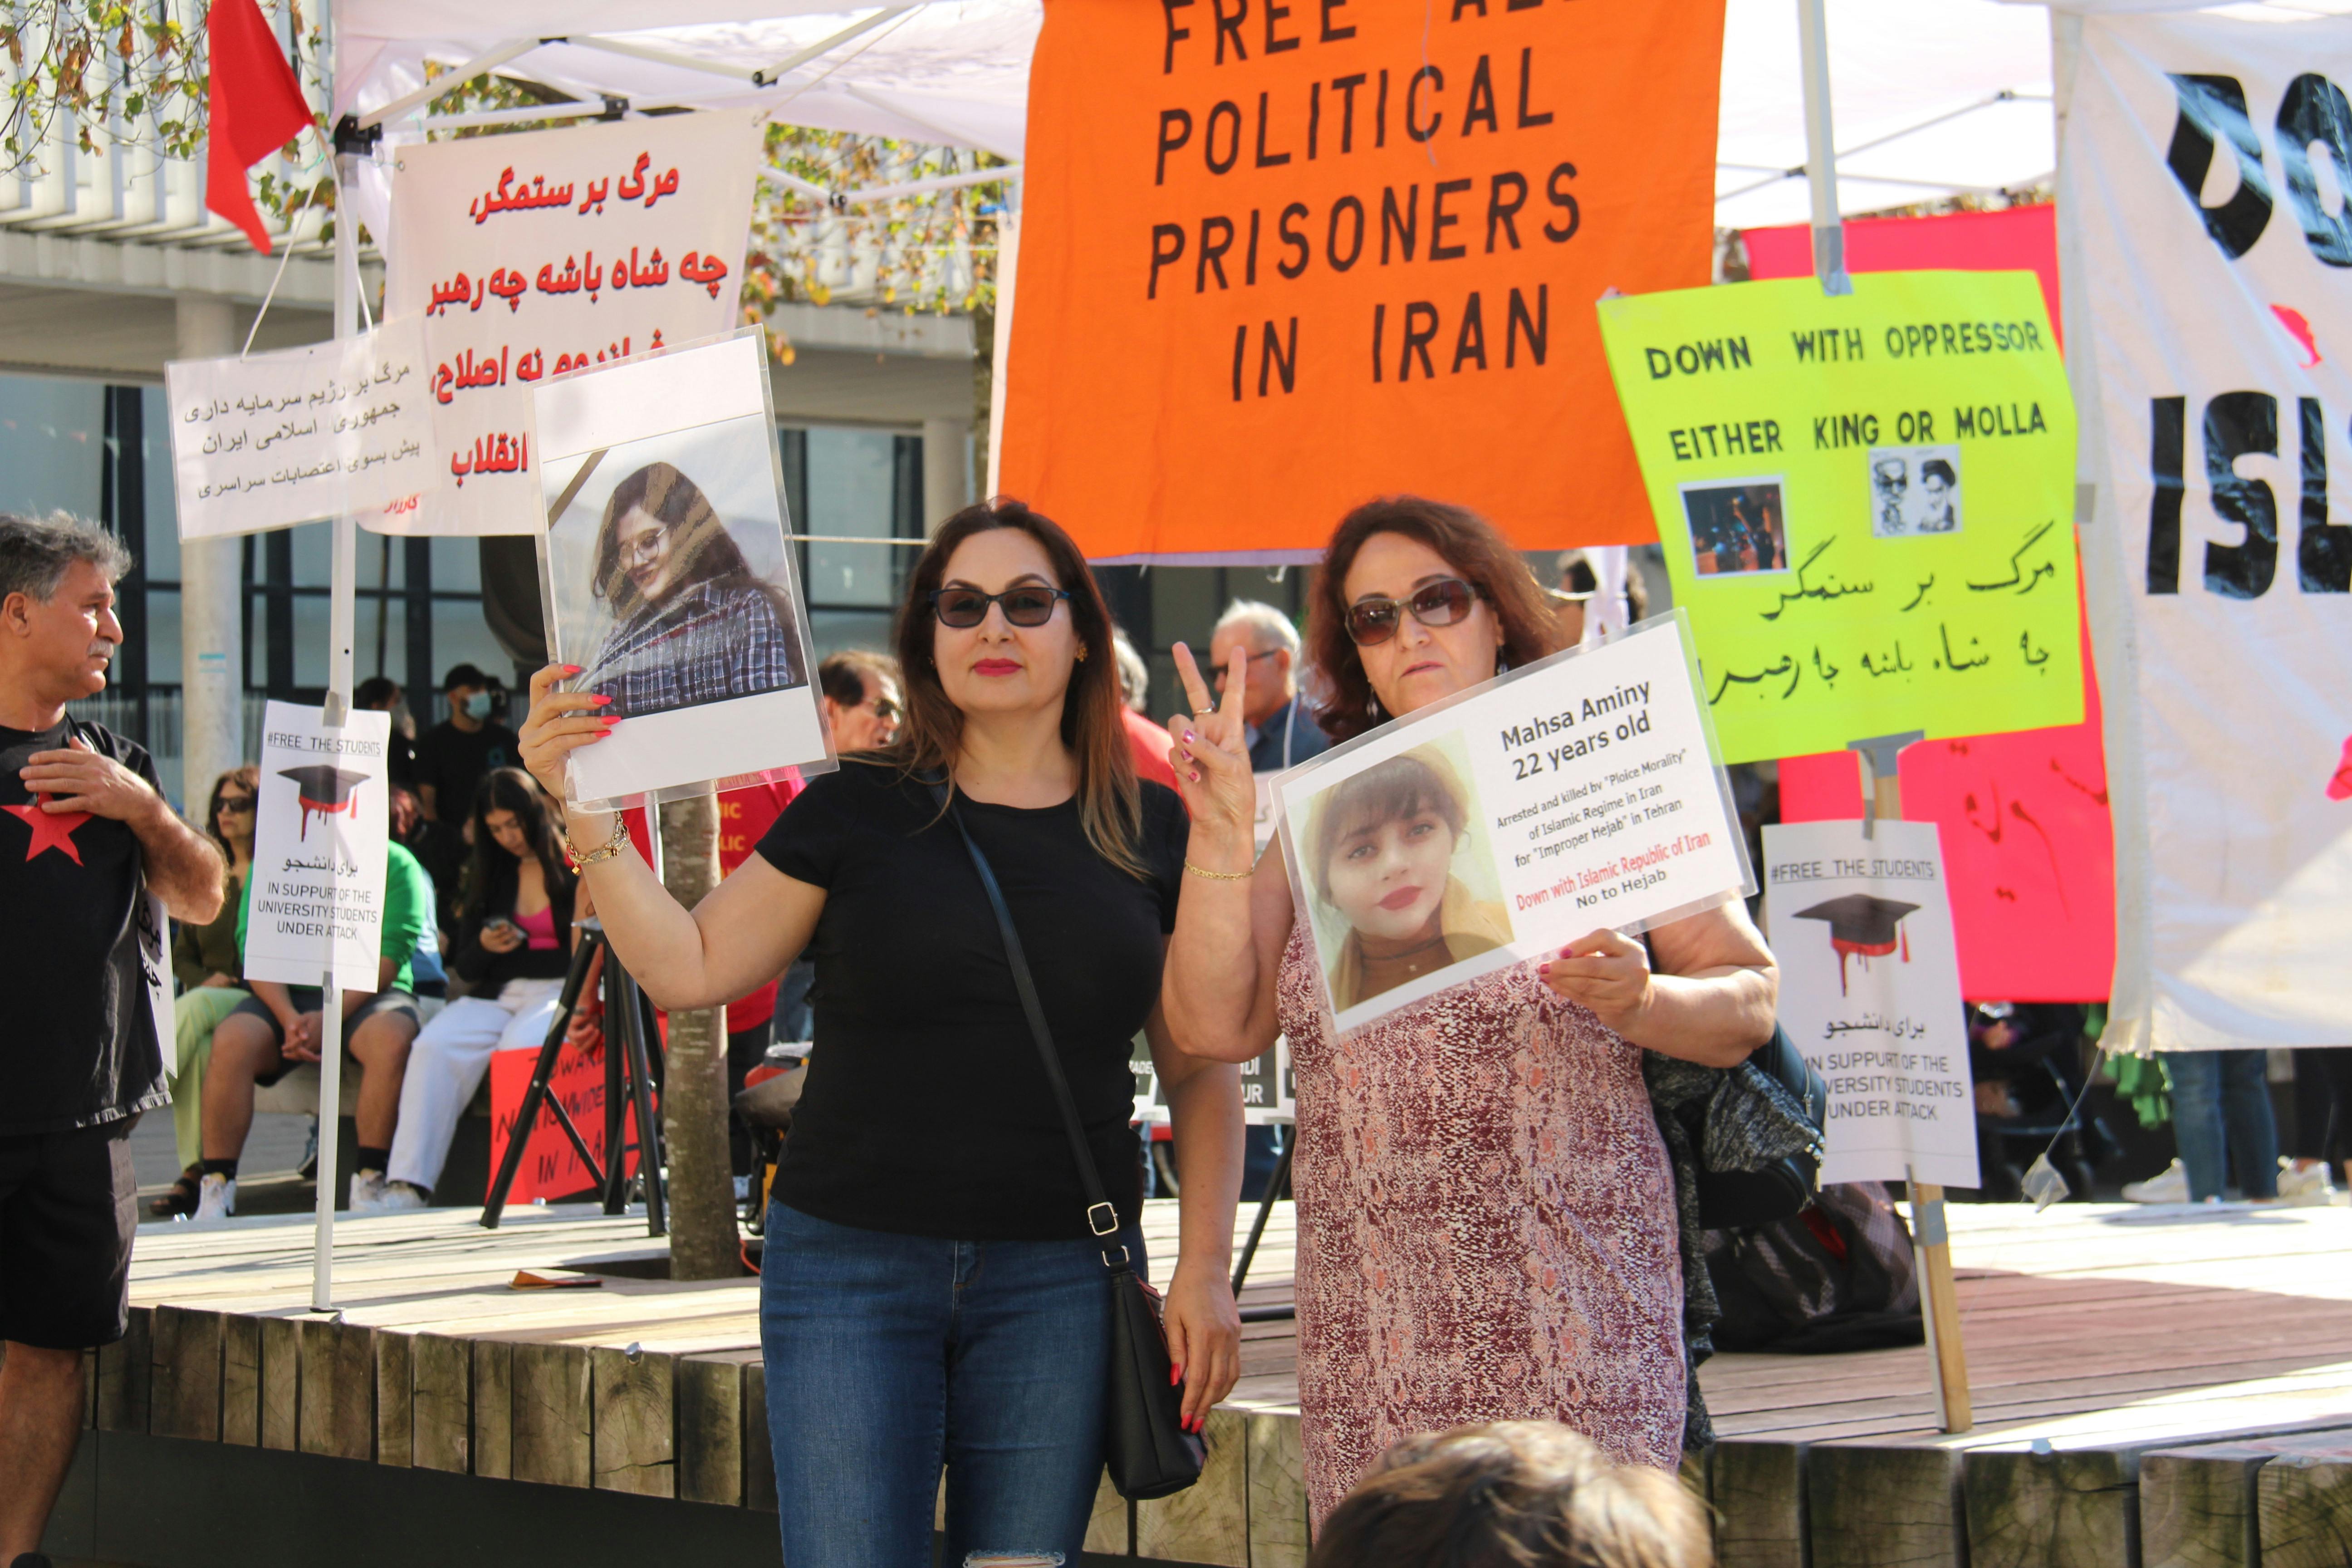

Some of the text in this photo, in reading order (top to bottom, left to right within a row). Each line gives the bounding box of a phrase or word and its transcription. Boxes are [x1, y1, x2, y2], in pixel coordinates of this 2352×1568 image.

[1162, 0, 1358, 75] FREE
[1154, 46, 1555, 187] POLITICAL
[579, 176, 608, 215] بر
[618, 152, 679, 207] مرگ
[1147, 161, 1581, 301] PRISONERS
[426, 246, 728, 317] چه شاه باشه چه رهبر
[1233, 283, 1548, 402] IN IRAN
[1644, 320, 2044, 380] DOWN WITH OPPRESSOR
[184, 362, 410, 423] مرگ بر رژیم سرمایه داری
[202, 401, 400, 454] جمهوری اسلامی ایران
[1669, 402, 2047, 461] EITHER KING OR MOLLA
[272, 460, 341, 485] اعتصابات
[347, 452, 387, 473] بسوی
[451, 431, 528, 487] انقلاب
[198, 476, 265, 499] سراسری
[2146, 389, 2352, 600] ISL
[1965, 519, 2056, 596] مرگ
[1900, 572, 1936, 612] بر
[1860, 640, 1914, 685] باشه
[1931, 621, 1991, 672] شاه
[267, 731, 381, 755] #FREE THE STUDENTS
[1499, 681, 1650, 752] Mahsa Aminy
[1512, 710, 1651, 781] 22 years old
[1497, 803, 1539, 829] Arrested
[1541, 795, 1559, 812] and
[1561, 784, 1588, 804] killed
[1604, 769, 1640, 787] "Ploice
[1528, 783, 1663, 841] of Islamic Regime in Iran
[1514, 799, 1683, 868] for "Improper Hejab" in Tehran
[268, 882, 279, 895] IN
[339, 887, 350, 901] OF
[353, 889, 372, 904] THE
[281, 856, 358, 879] برای دانشجو
[1516, 832, 1711, 911] Down with Islamic Republic of Iran
[1576, 868, 1667, 909] No to Hejab
[1771, 859, 1935, 882] #FREE THE STUDENTS
[258, 900, 377, 924] UNIVERSITY STUDENTS
[277, 921, 358, 941] UNDER ATTACK
[1822, 1013, 1926, 1040] برای دانشجو
[1894, 1077, 1963, 1098] STUDENTS
[1901, 1053, 1918, 1070] OF
[1921, 1054, 1950, 1073] THE
[1827, 1100, 1938, 1121] UNDER ATTACK
